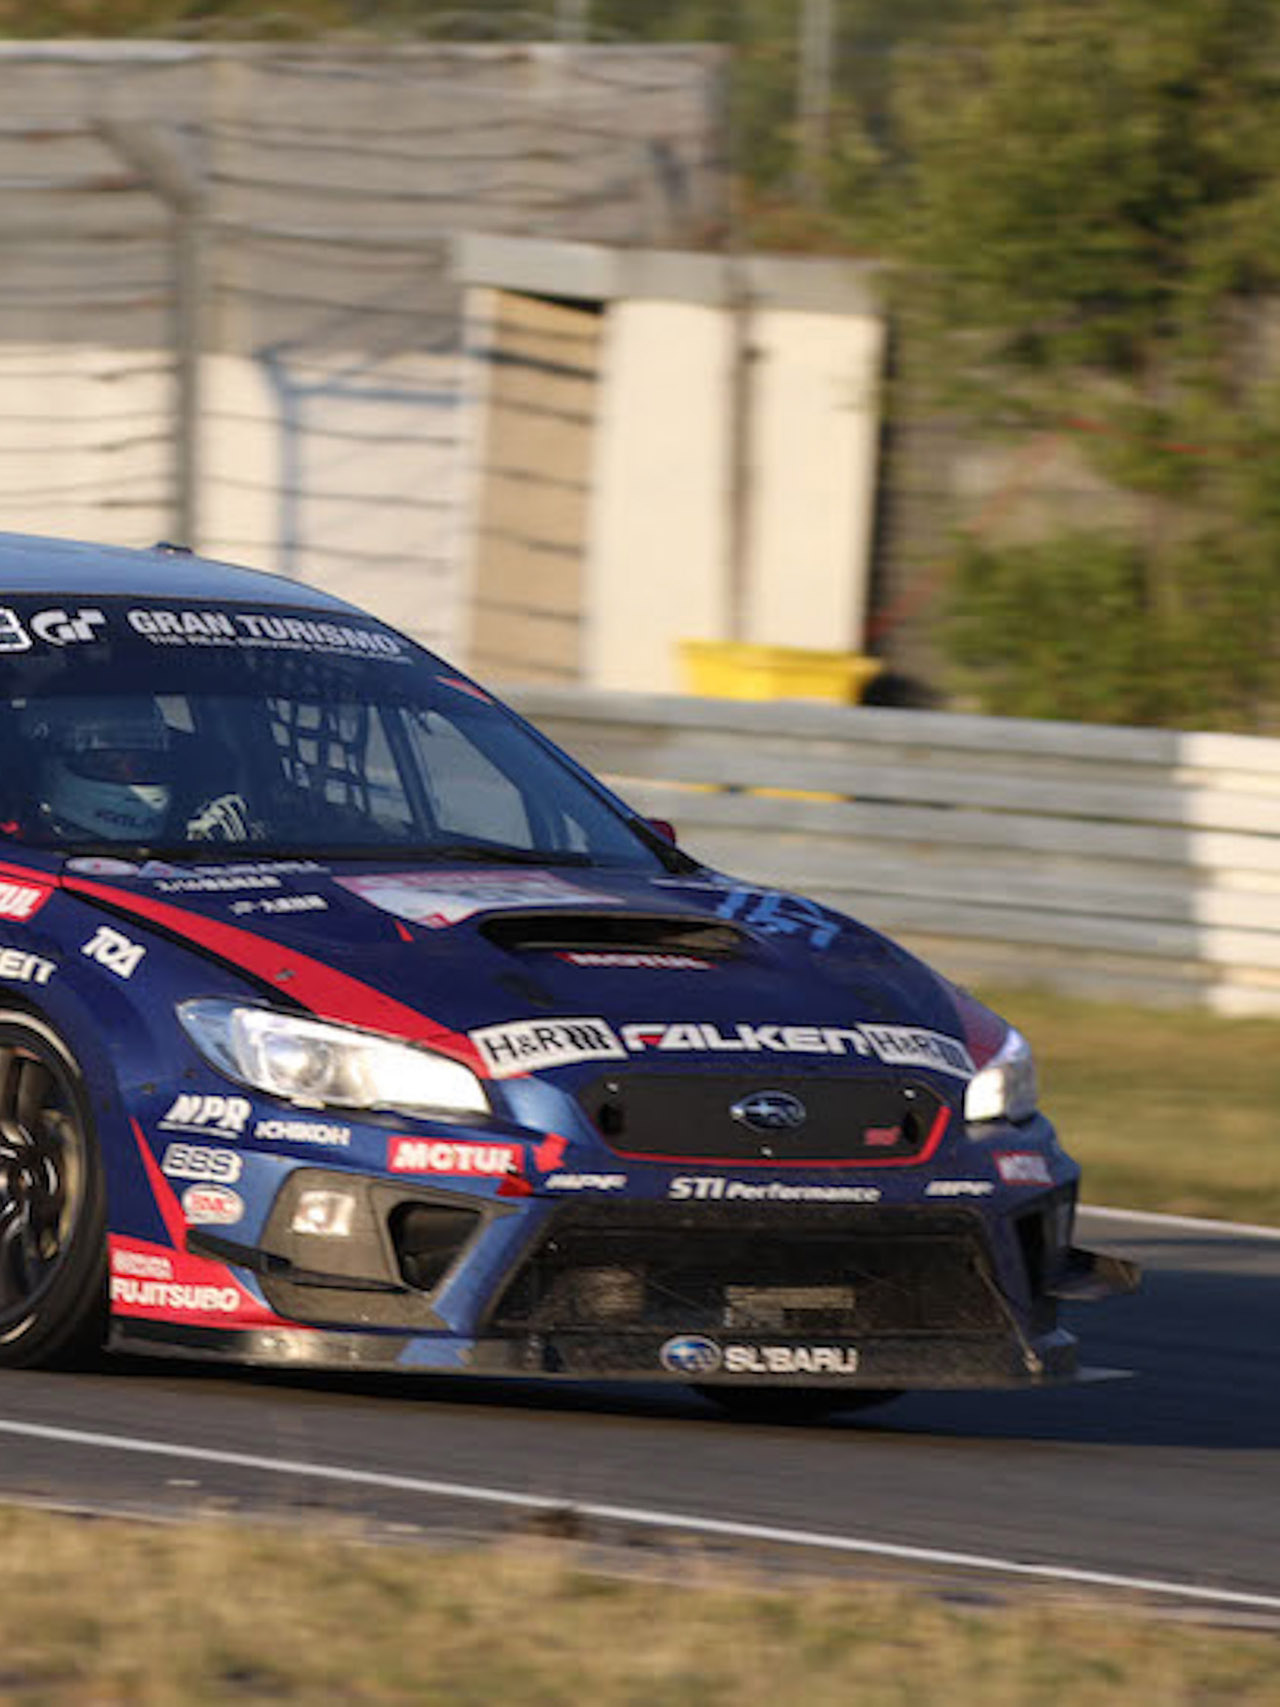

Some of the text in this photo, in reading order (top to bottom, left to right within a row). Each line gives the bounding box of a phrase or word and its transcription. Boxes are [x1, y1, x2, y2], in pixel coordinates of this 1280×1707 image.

[127, 608, 236, 637] GRAN
[235, 613, 401, 656] TURISMO
[483, 1028, 566, 1065] H&R
[620, 1022, 873, 1057] FALKEN
[164, 1094, 253, 1133] NPR
[392, 1140, 519, 1174] MOTUL
[667, 1177, 882, 1203] STI Performance
[109, 1277, 241, 1313] FUJITSUBO
